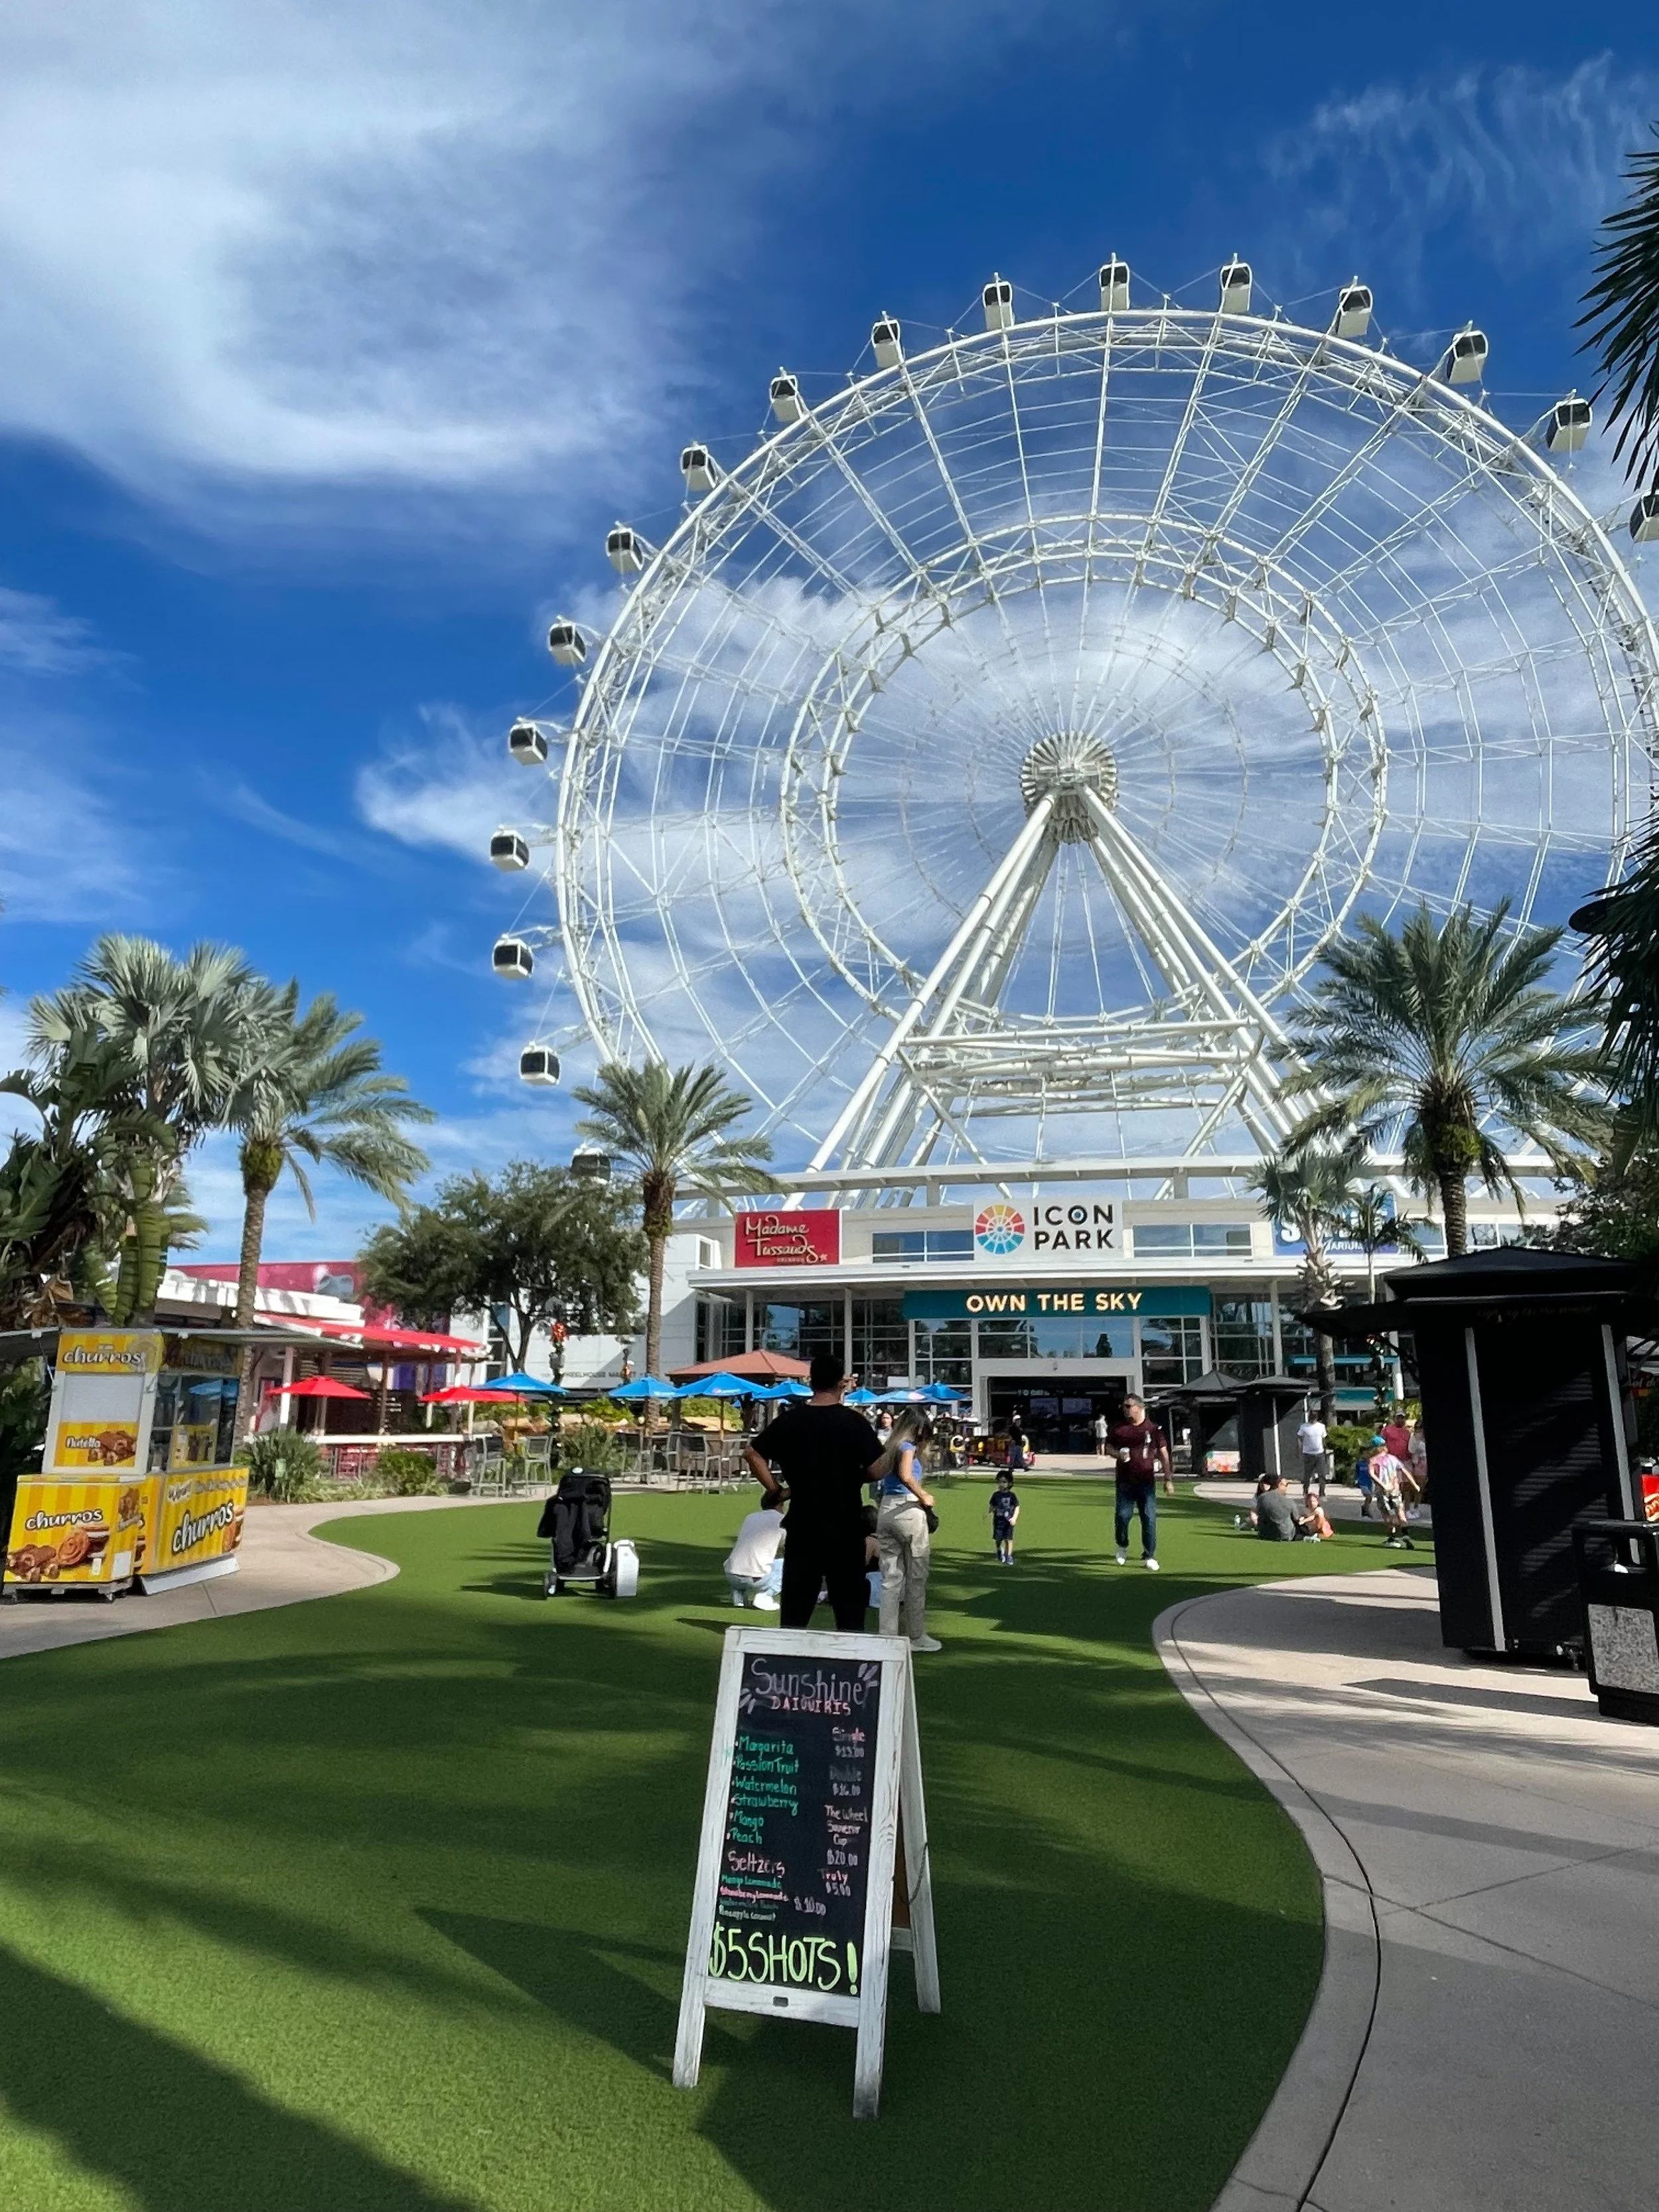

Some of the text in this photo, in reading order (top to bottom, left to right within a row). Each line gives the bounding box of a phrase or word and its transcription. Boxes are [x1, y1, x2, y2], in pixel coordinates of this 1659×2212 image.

[1034, 1204, 1114, 1226] ICON
[745, 1215, 810, 1238] Madame
[747, 1234, 819, 1264] Tussauds
[1035, 1228, 1114, 1250] PARK
[966, 1292, 1143, 1313] OWN THE SKY
[63, 1345, 143, 1365] churros
[66, 1436, 100, 1449] Nutella
[25, 1509, 103, 1530] churros
[171, 1500, 234, 1556] churros
[751, 1658, 865, 1705] Sunshine
[739, 1735, 794, 1760] Margarita
[735, 1776, 797, 1796] Watermelon
[733, 1793, 799, 1817] Strawberry
[824, 1805, 841, 1820] The
[733, 1810, 764, 1832] Mango
[729, 1827, 762, 1845] Peach
[727, 1850, 786, 1879] Seltzers
[817, 1868, 849, 1886] Truly
